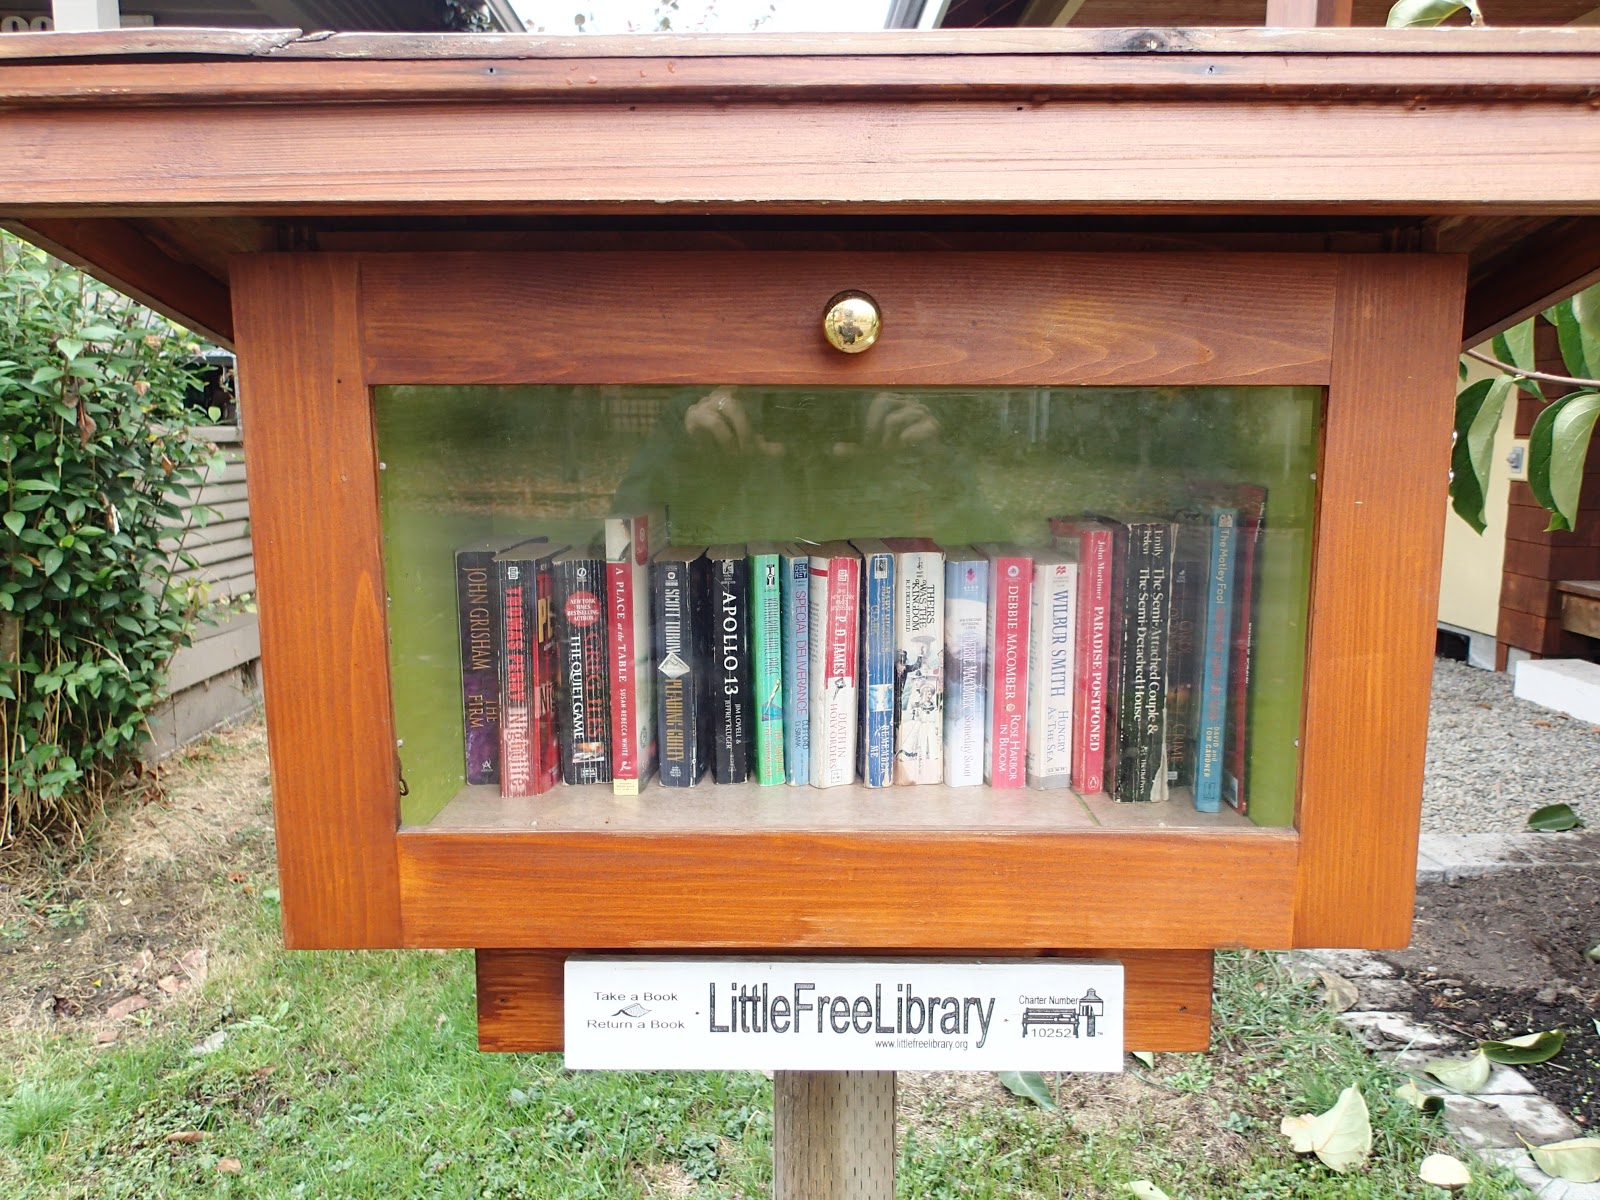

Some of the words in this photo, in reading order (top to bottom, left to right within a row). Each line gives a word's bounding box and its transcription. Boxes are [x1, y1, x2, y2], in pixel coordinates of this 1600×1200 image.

[1097, 540, 1106, 560] John
[1142, 530, 1152, 555] Eden
[1151, 530, 1164, 558] Emily
[1219, 529, 1230, 548] The
[1095, 562, 1105, 600] Mortimer
[1139, 567, 1150, 590] The
[1152, 567, 1165, 590] The
[1215, 549, 1228, 582] Motley
[462, 567, 488, 604] JOHN
[616, 581, 625, 619] PLACE
[665, 588, 680, 617] SCOTT
[881, 586, 891, 610] MARY
[919, 579, 928, 606] WAS
[1216, 583, 1226, 604] Fool
[505, 586, 524, 650] THOMAS
[764, 597, 778, 636] KATHERINE
[796, 590, 807, 638] SPECIAL
[835, 615, 847, 625] P.
[871, 605, 880, 636] CLARK
[911, 578, 920, 631] KINGDOM
[919, 606, 927, 629] THE
[926, 584, 935, 624] THEIRS
[1007, 586, 1019, 630] DEBBIE
[1051, 590, 1068, 644] WILBUR
[469, 607, 491, 670] GRISHAM
[617, 622, 624, 631] at
[665, 620, 681, 654] TUROW
[722, 591, 738, 671] APOLLO
[835, 629, 847, 639] D.
[1092, 606, 1104, 670] PARADISE
[1135, 592, 1149, 683] Semi-Detached
[1149, 592, 1164, 680] Semi-Attached
[571, 633, 581, 660] THE
[585, 633, 602, 690] GREG
[764, 637, 778, 655] HALL
[833, 643, 847, 675] JAMES
[962, 634, 977, 664] DEBBIE
[508, 654, 525, 701] PERRY
[569, 661, 582, 700] QUIET
[618, 644, 627, 683] TABLE
[764, 657, 779, 677] PAGE
[796, 640, 808, 717] DELIVERANCE
[1005, 633, 1018, 700] MACOMBER
[1051, 649, 1067, 698] SMITH
[665, 679, 683, 726] PLEADING
[723, 676, 738, 695] 13
[962, 665, 978, 710] MACOMBER
[1145, 681, 1160, 722] Couple
[468, 694, 484, 729] FIRM
[485, 700, 498, 723] THE
[587, 699, 604, 737] ILES
[829, 703, 838, 729] HOLY
[1089, 672, 1102, 751] POSTPONED
[1134, 685, 1145, 722] House
[573, 702, 584, 740] GAME
[620, 709, 628, 736] REBECCA
[837, 712, 847, 743] DEATH
[960, 715, 975, 754] Someday
[1010, 715, 1021, 738] ROSE
[1047, 721, 1057, 742] THE
[1057, 710, 1069, 753] HUNGRY
[1146, 724, 1159, 735] &
[1212, 726, 1220, 748] DAVID
[504, 711, 529, 788] Nightlife
[666, 729, 684, 762] GUILTY
[829, 731, 838, 769] ORDERS
[837, 746, 847, 758] IN
[870, 745, 879, 758] ME
[881, 724, 890, 774] REMEMBER
[998, 737, 1009, 772] BLOOM
[1046, 744, 1055, 763] SEA
[1171, 723, 1186, 762] CRIME
[963, 755, 974, 777] Soon
[1009, 740, 1021, 780] HARBOR
[1203, 744, 1212, 778] GARDNER
[593, 991, 626, 1001] Take
[643, 991, 678, 1001] Book
[1019, 995, 1047, 1005] Charter
[1048, 996, 1079, 1005] Number
[587, 1019, 632, 1028] Return
[650, 1020, 685, 1028] Book
[709, 982, 996, 1048] LittleFreeLibrary
[875, 1038, 968, 1050] www.littlefreelibrary.org
[1031, 1028, 1072, 1038] 10252
